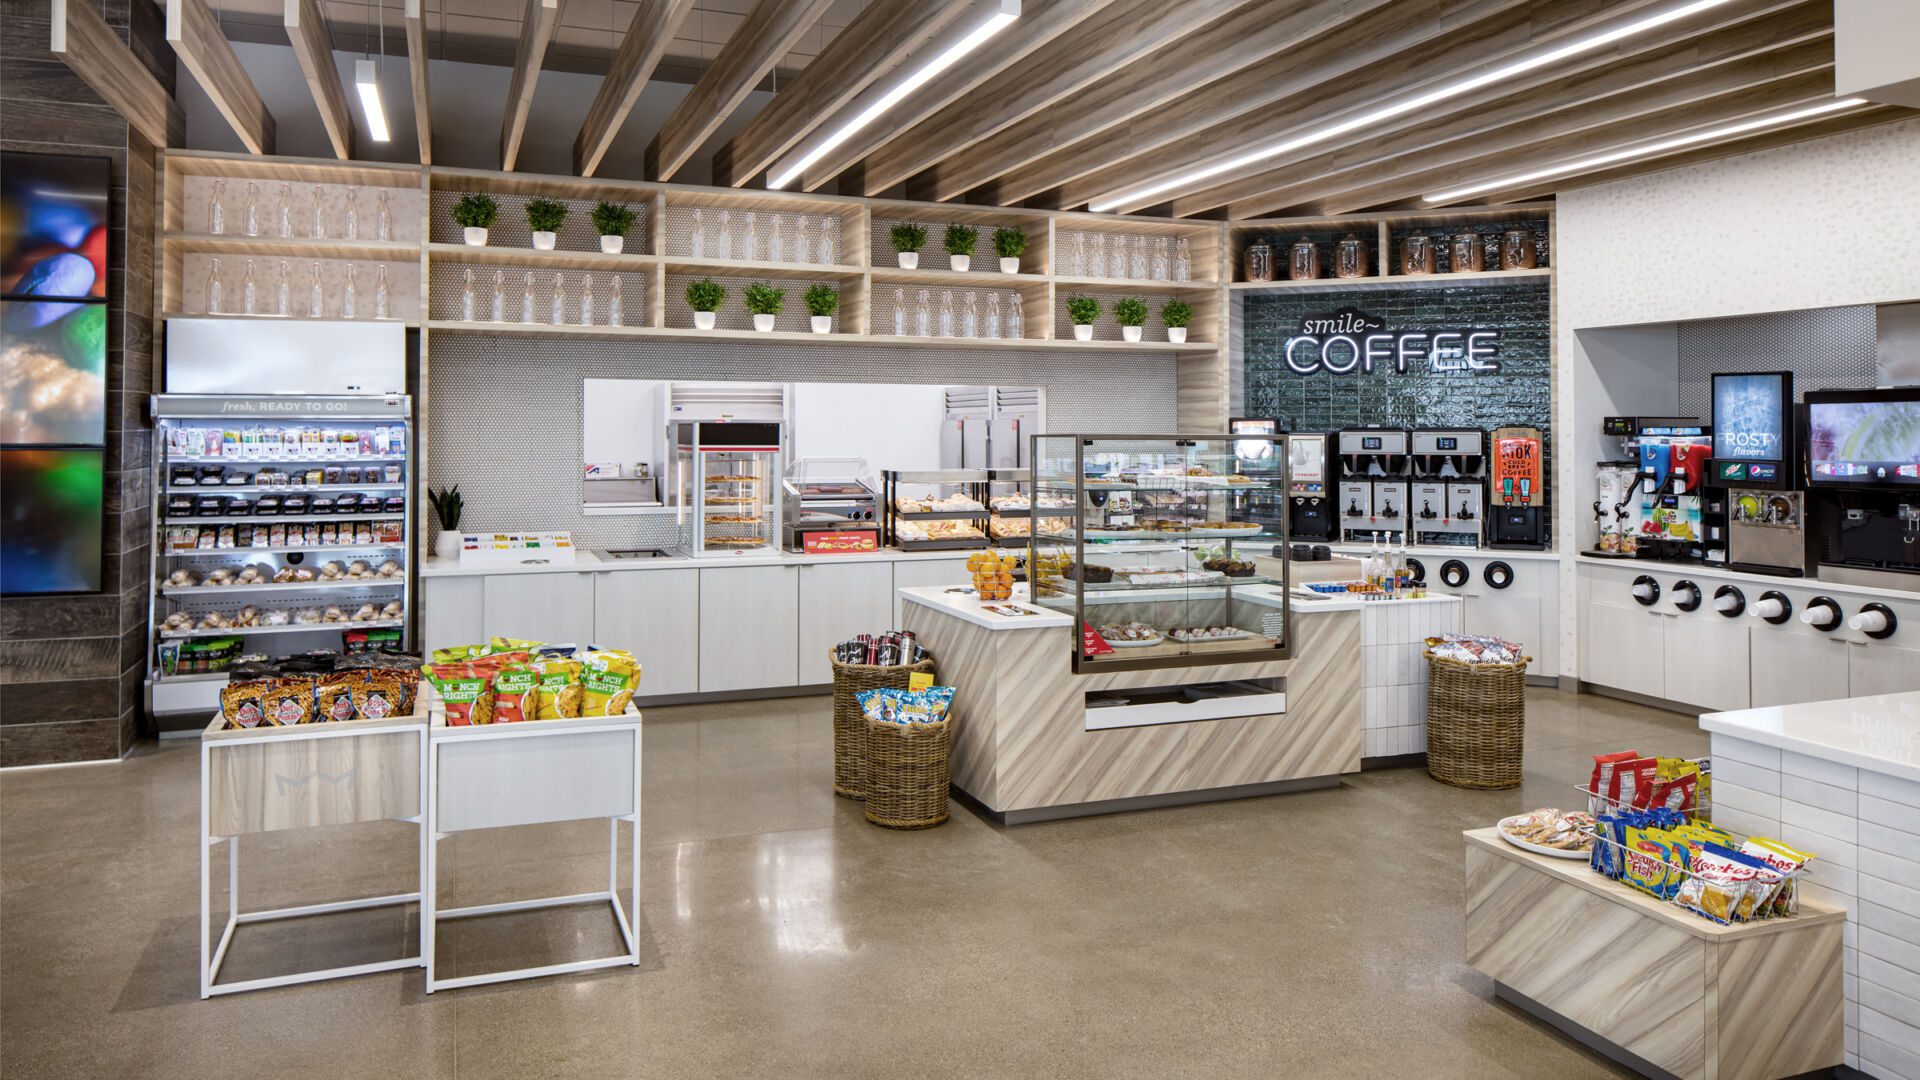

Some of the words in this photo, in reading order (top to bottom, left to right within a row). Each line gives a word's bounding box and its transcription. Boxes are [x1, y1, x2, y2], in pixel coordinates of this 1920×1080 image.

[1288, 332, 1498, 373] COFFEE
[221, 401, 256, 413] fresh,
[260, 402, 300, 411] READY
[305, 402, 321, 411] TO
[325, 402, 348, 411] GO!
[1715, 432, 1781, 446] FROSTY
[1732, 446, 1765, 456] flavors
[1631, 860, 1654, 881] Fish
